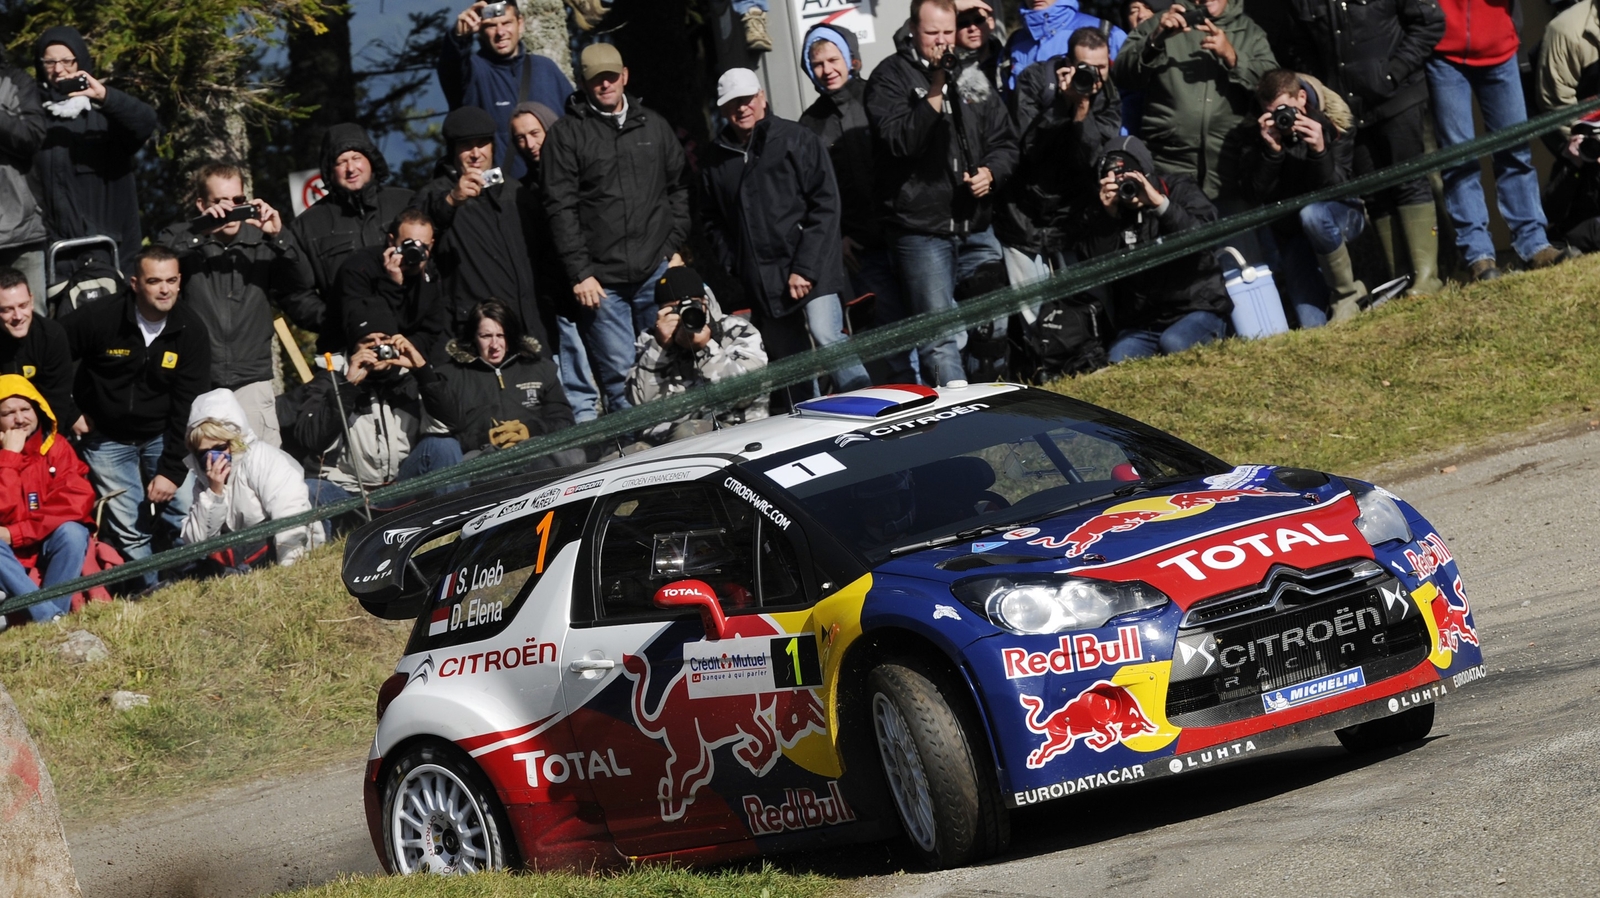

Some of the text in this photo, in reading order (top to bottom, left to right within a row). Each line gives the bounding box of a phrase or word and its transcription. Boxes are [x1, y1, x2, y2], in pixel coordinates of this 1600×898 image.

[647, 470, 691, 483] FINANCEMENT
[791, 462, 816, 477] 1
[535, 510, 555, 575] 1
[1156, 522, 1351, 581] TOTAL
[353, 569, 393, 583] LUHTA
[456, 559, 504, 595] S. Loeb
[663, 588, 702, 597] TOTAL
[451, 599, 503, 632] D. Elena
[1219, 607, 1382, 669] CITROËN
[438, 637, 557, 678] CITROËN
[690, 652, 767, 672] Crédit Mutuel
[785, 637, 803, 686] 1
[702, 673, 726, 682] banque
[734, 671, 745, 681] qui
[747, 669, 767, 680] parler
[1290, 671, 1359, 700] MICHELIN
[1401, 684, 1448, 707] LUHTA
[513, 748, 632, 787] TOTAL
[1187, 740, 1257, 767] LUHTA
[1014, 764, 1146, 806] EURODATACAR
